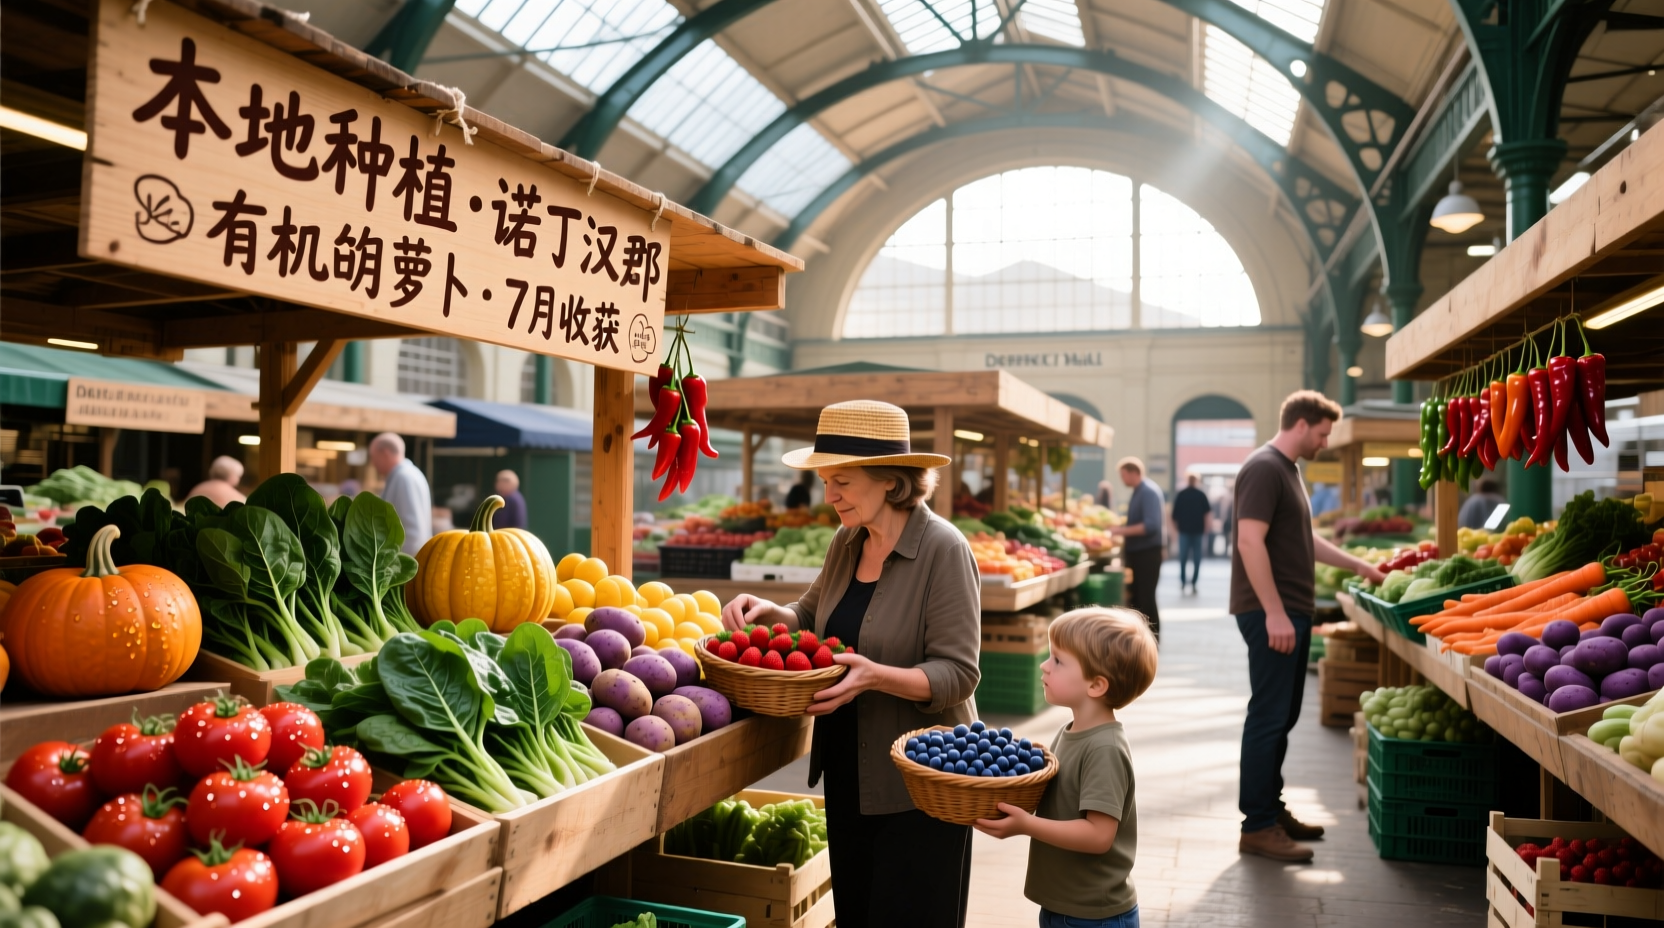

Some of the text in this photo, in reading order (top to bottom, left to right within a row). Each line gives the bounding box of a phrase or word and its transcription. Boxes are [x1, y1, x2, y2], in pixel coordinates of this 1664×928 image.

[132, 36, 662, 303] 本地种植·诺丁汉郡
